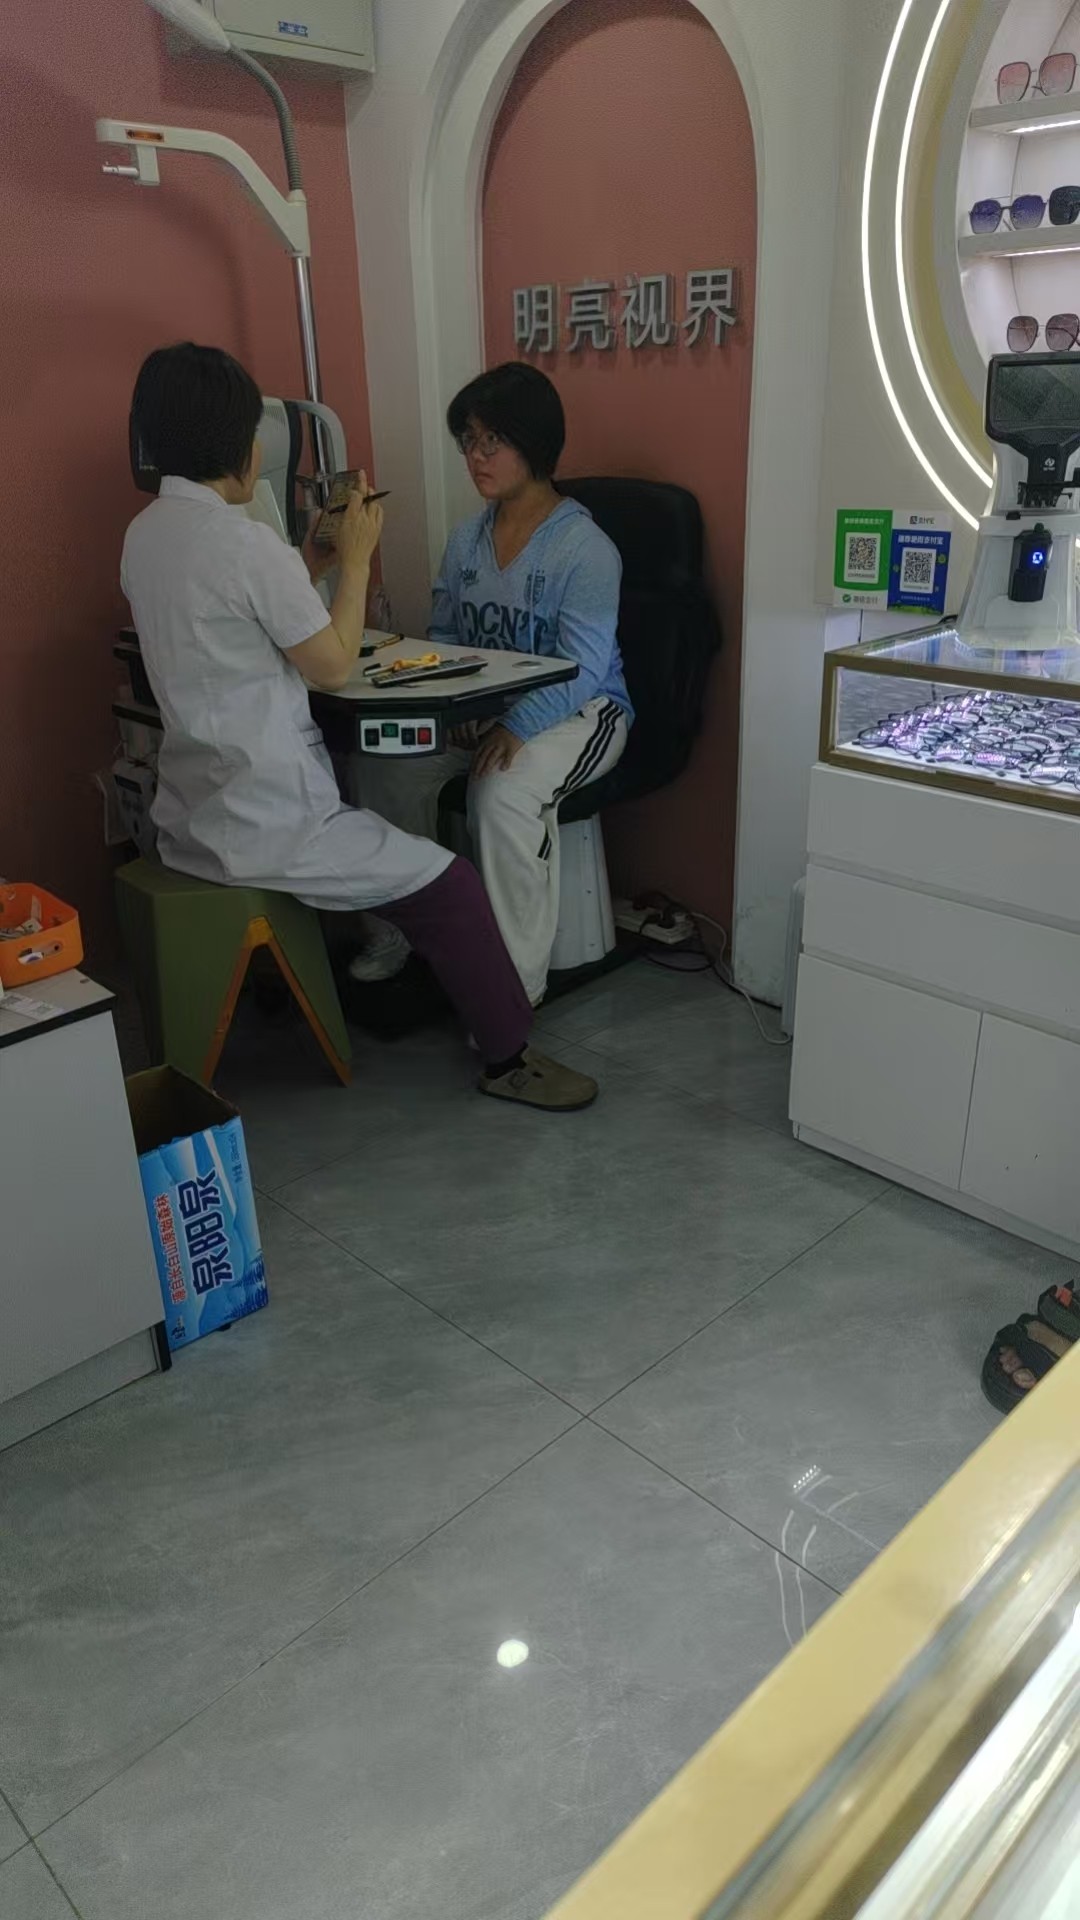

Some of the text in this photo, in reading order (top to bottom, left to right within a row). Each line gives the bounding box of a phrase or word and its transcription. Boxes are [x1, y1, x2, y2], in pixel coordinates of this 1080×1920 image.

[513, 269, 736, 353] 明亮视界
[155, 1193, 186, 1303] 源自长白山原始森林
[178, 1168, 234, 1295] 泉阳泉
